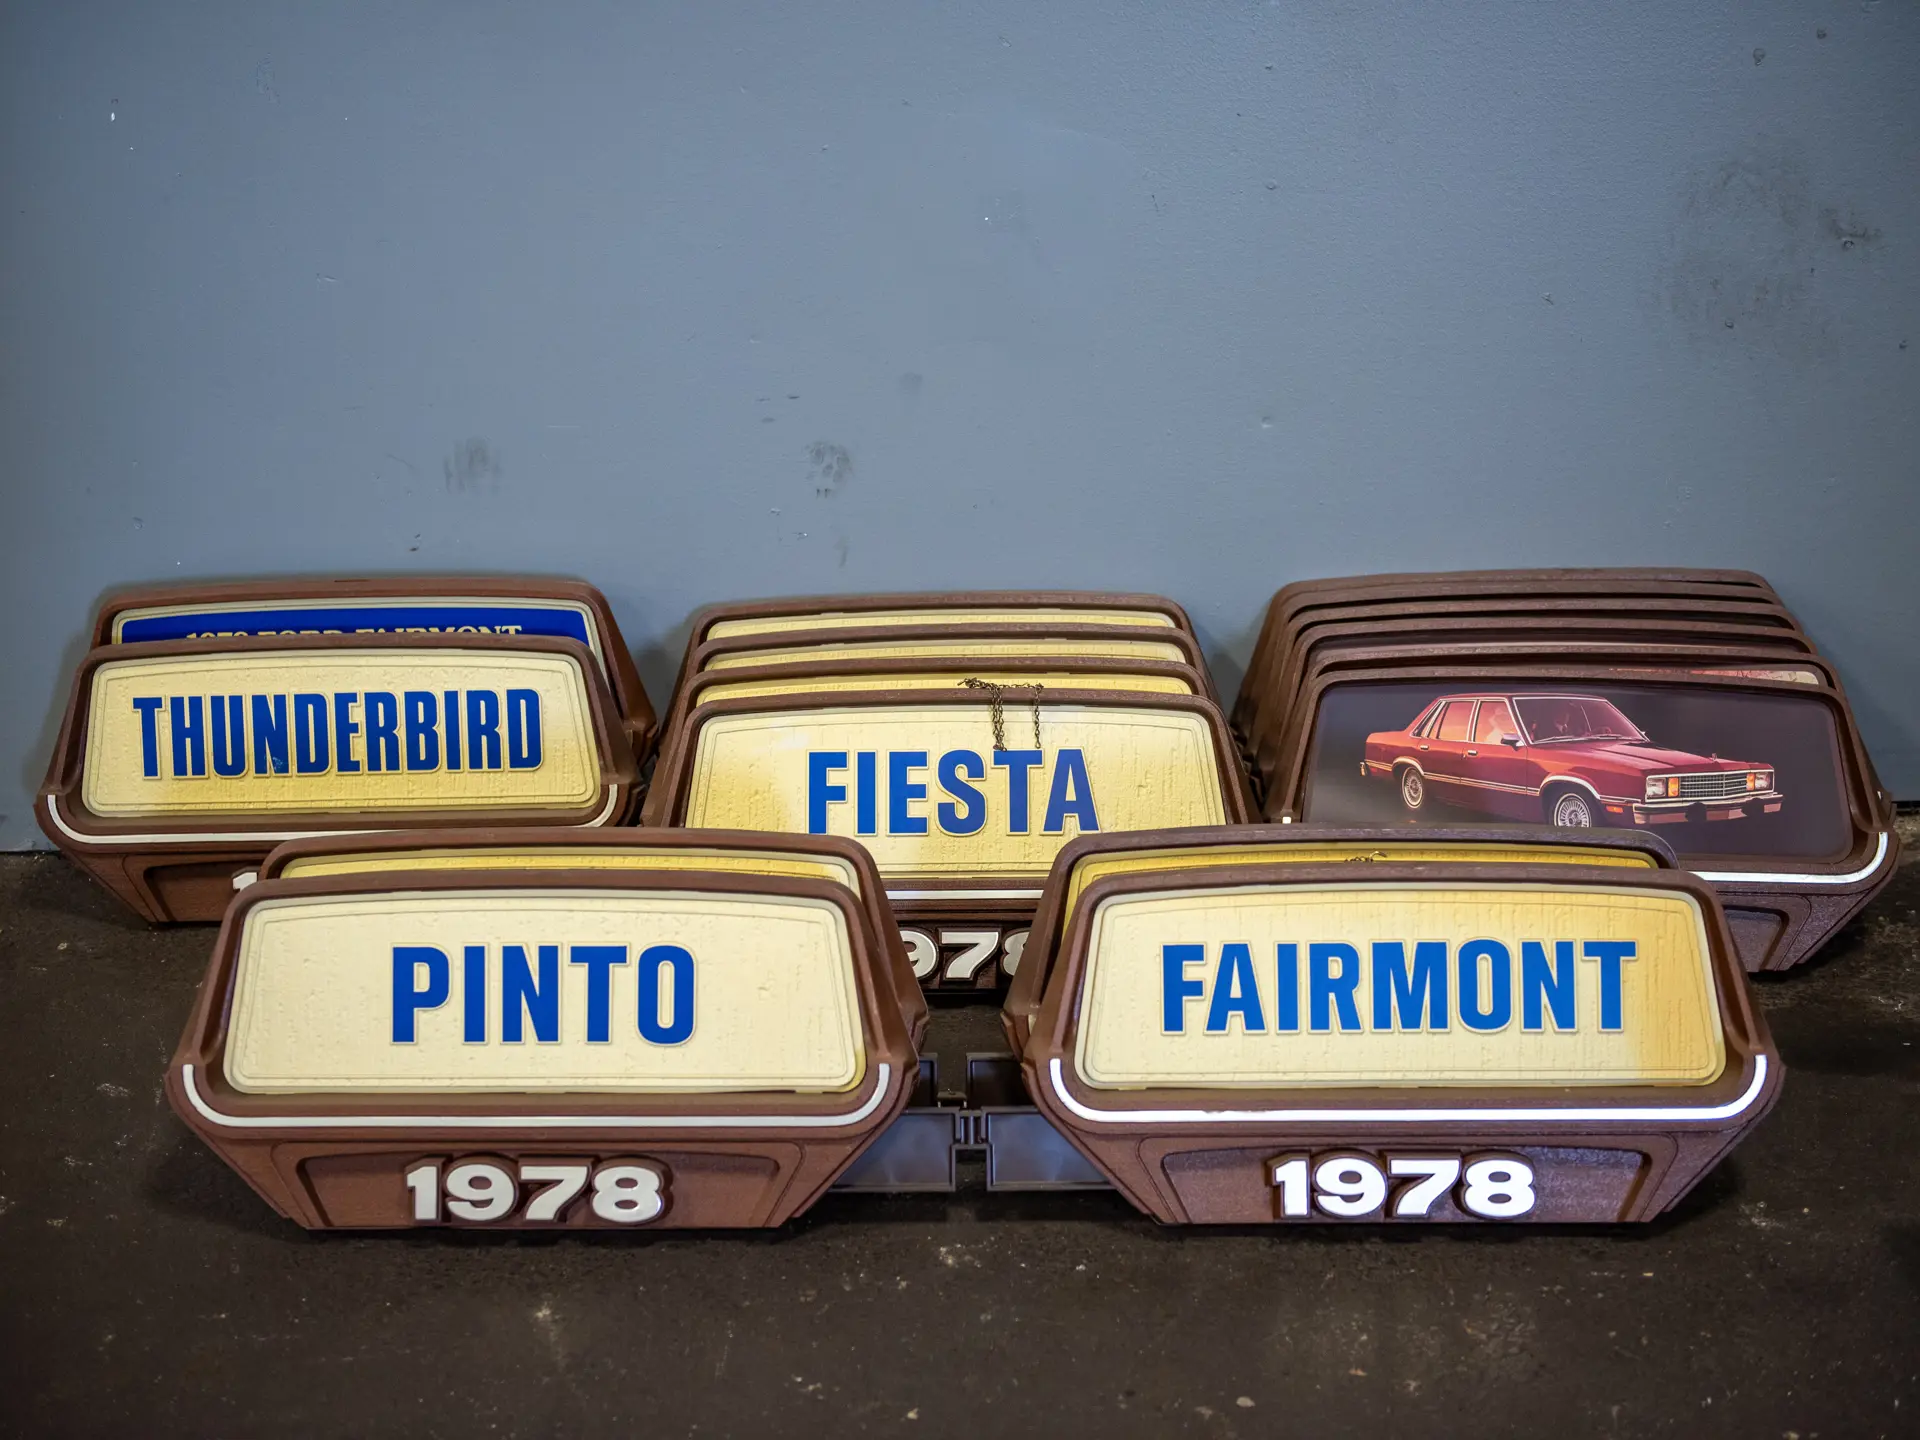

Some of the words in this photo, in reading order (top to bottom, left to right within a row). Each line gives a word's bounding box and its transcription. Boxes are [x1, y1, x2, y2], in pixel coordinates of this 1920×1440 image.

[132, 688, 542, 778] THUNDERBIRD
[808, 749, 1100, 836] FIESTA
[392, 945, 696, 1046] PINTO
[1162, 939, 1637, 1034] FAIRMONT
[407, 1164, 663, 1222] 1978
[1275, 1157, 1536, 1218] 1978
